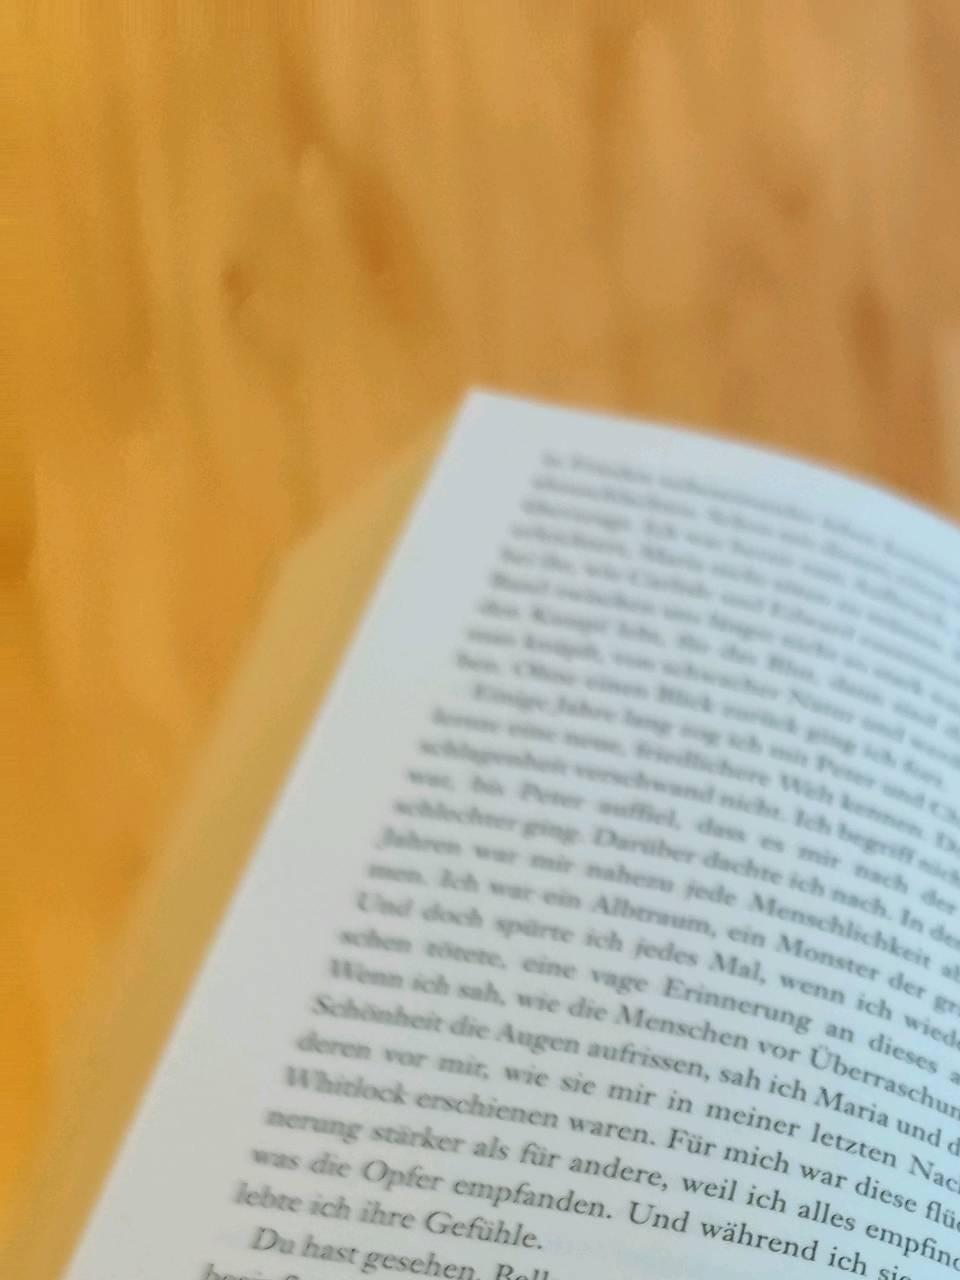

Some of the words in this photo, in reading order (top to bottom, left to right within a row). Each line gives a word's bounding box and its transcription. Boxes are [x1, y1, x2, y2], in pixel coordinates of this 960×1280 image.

[809, 1122, 897, 1168] letzten
[304, 1151, 353, 1179] die
[358, 1159, 445, 1192] Opfer
[450, 1179, 612, 1219] empfanden.
[627, 1200, 691, 1233] Und
[700, 1221, 819, 1262] während
[827, 1246, 867, 1277] ich
[517, 1141, 562, 1169] für
[567, 1156, 668, 1192] andere,
[680, 1177, 738, 1202] weil
[745, 1184, 787, 1214] ich
[796, 1200, 856, 1232] alles
[247, 1226, 297, 1256] Du
[297, 1233, 359, 1265] hast
[305, 1194, 352, 1221] ich
[355, 1199, 417, 1230] ihre
[421, 1210, 542, 1250] Gefühle.
